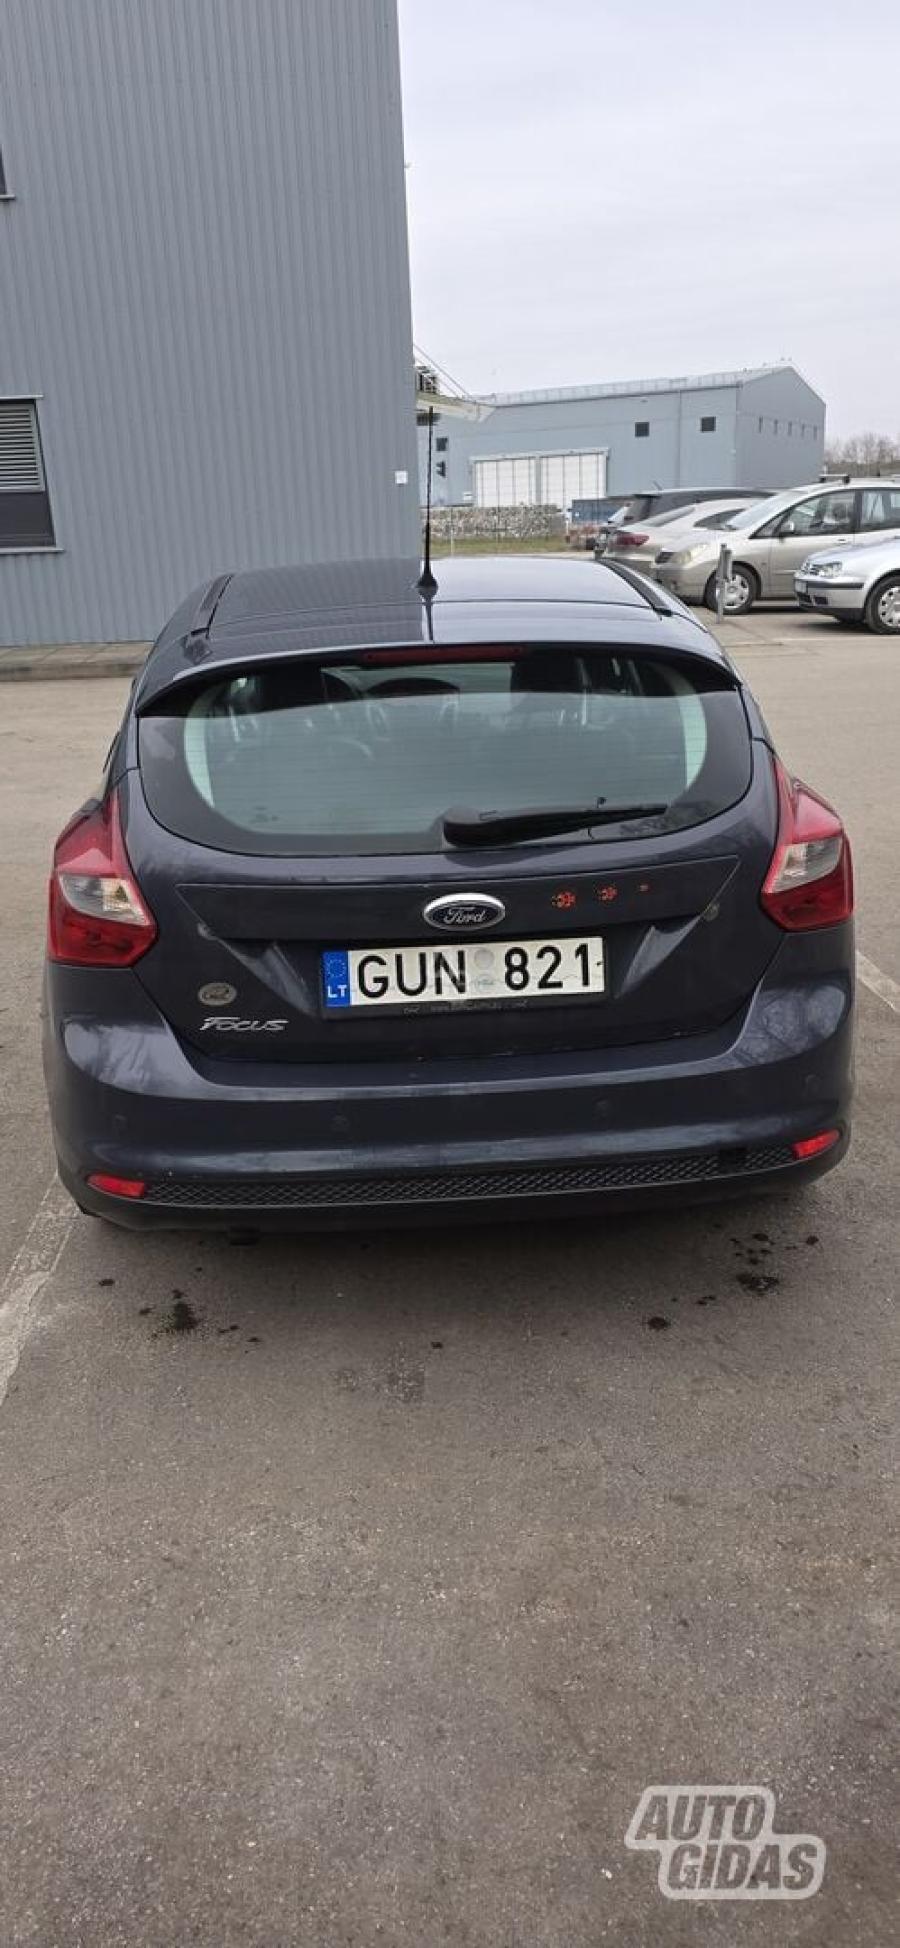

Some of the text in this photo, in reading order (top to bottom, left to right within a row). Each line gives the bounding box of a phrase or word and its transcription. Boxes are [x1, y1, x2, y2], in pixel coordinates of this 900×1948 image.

[443, 906, 487, 924] Ford
[357, 943, 590, 998] GUN 821
[327, 984, 347, 998] LT
